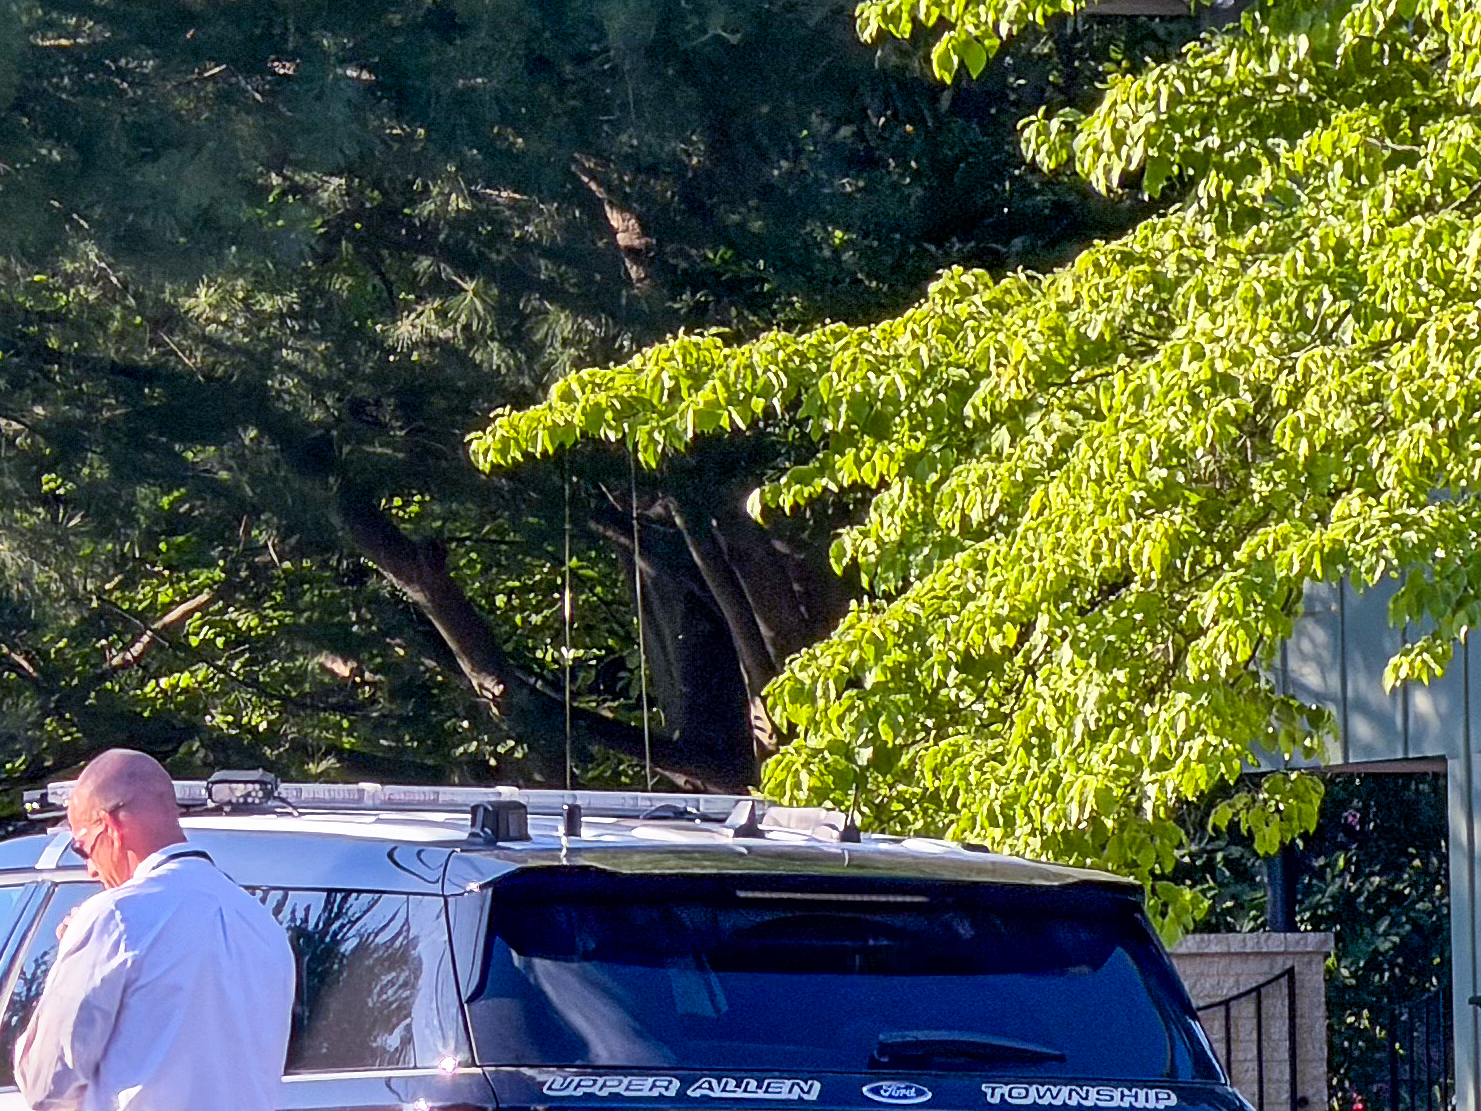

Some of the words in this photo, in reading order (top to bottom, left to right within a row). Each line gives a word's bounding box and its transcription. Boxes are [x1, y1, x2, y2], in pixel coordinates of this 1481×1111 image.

[543, 1076, 681, 1097] UPPER
[686, 1077, 822, 1101] ALLEN
[880, 1083, 917, 1098] Ford
[981, 1083, 1178, 1109] TOWNSHIP
